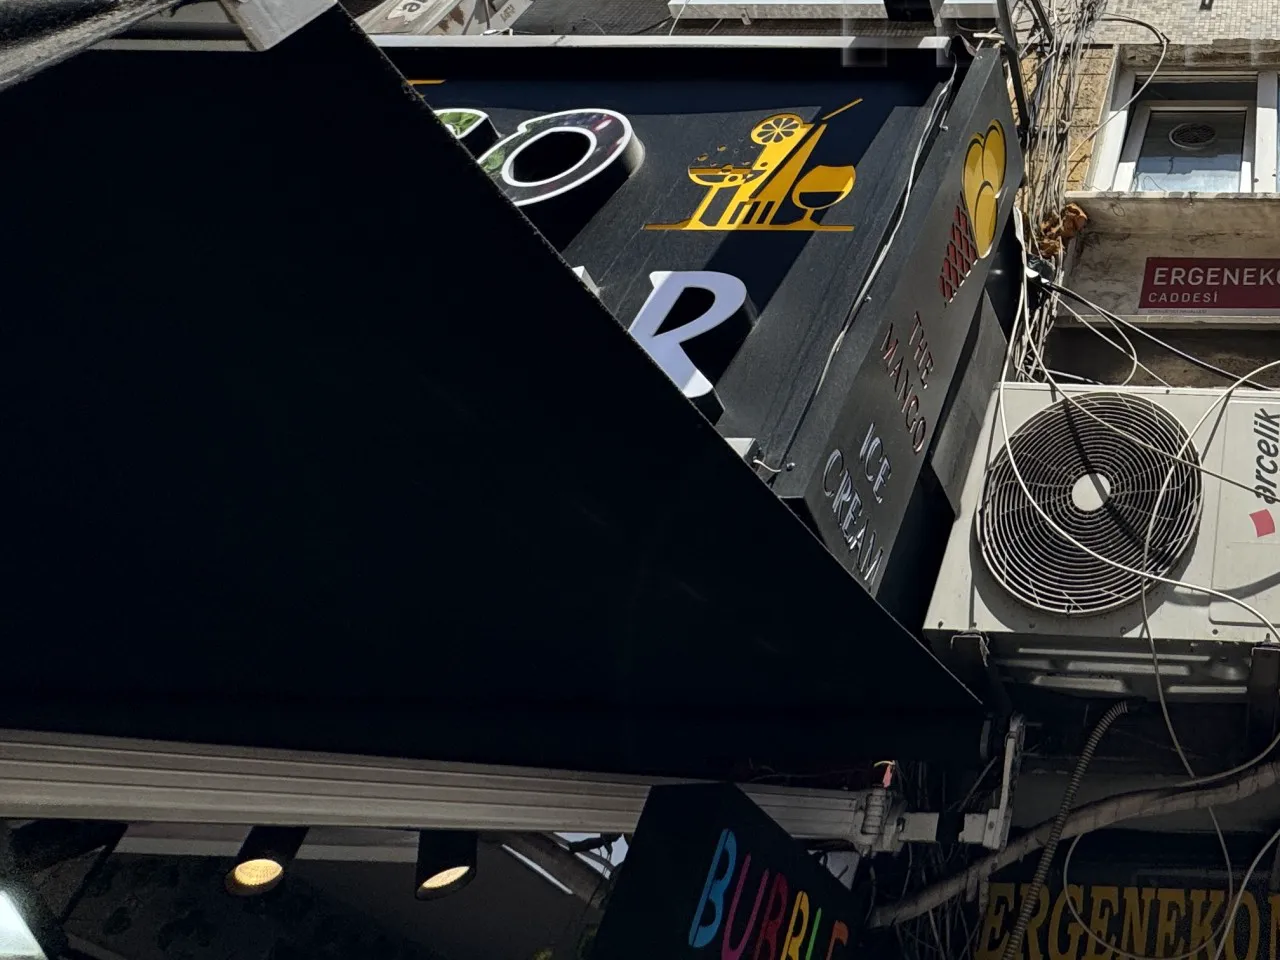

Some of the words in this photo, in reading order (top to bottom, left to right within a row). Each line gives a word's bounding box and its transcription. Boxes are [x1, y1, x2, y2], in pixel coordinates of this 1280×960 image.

[1148, 290, 1218, 303] CADDESİ
[880, 322, 927, 454] MANGO
[907, 311, 936, 390] THE
[859, 422, 893, 505] ICE
[822, 448, 885, 586] CREAM
